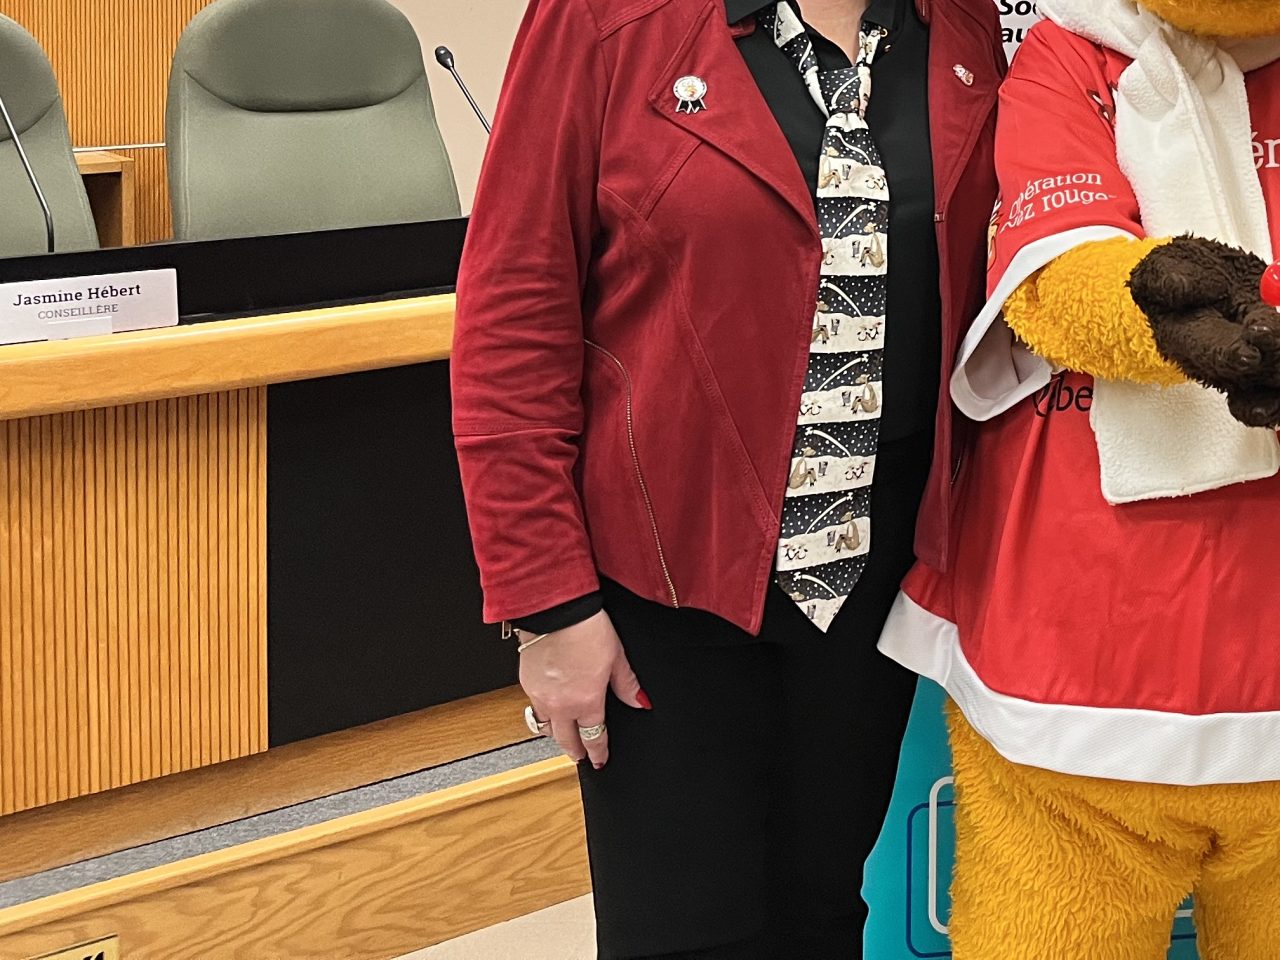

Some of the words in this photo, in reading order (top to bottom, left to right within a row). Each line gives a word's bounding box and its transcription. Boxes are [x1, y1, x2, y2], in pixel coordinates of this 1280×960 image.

[13, 290, 83, 307] Jasmine
[88, 284, 141, 300] Hébert
[38, 303, 119, 320] CONSEILLÈRE
